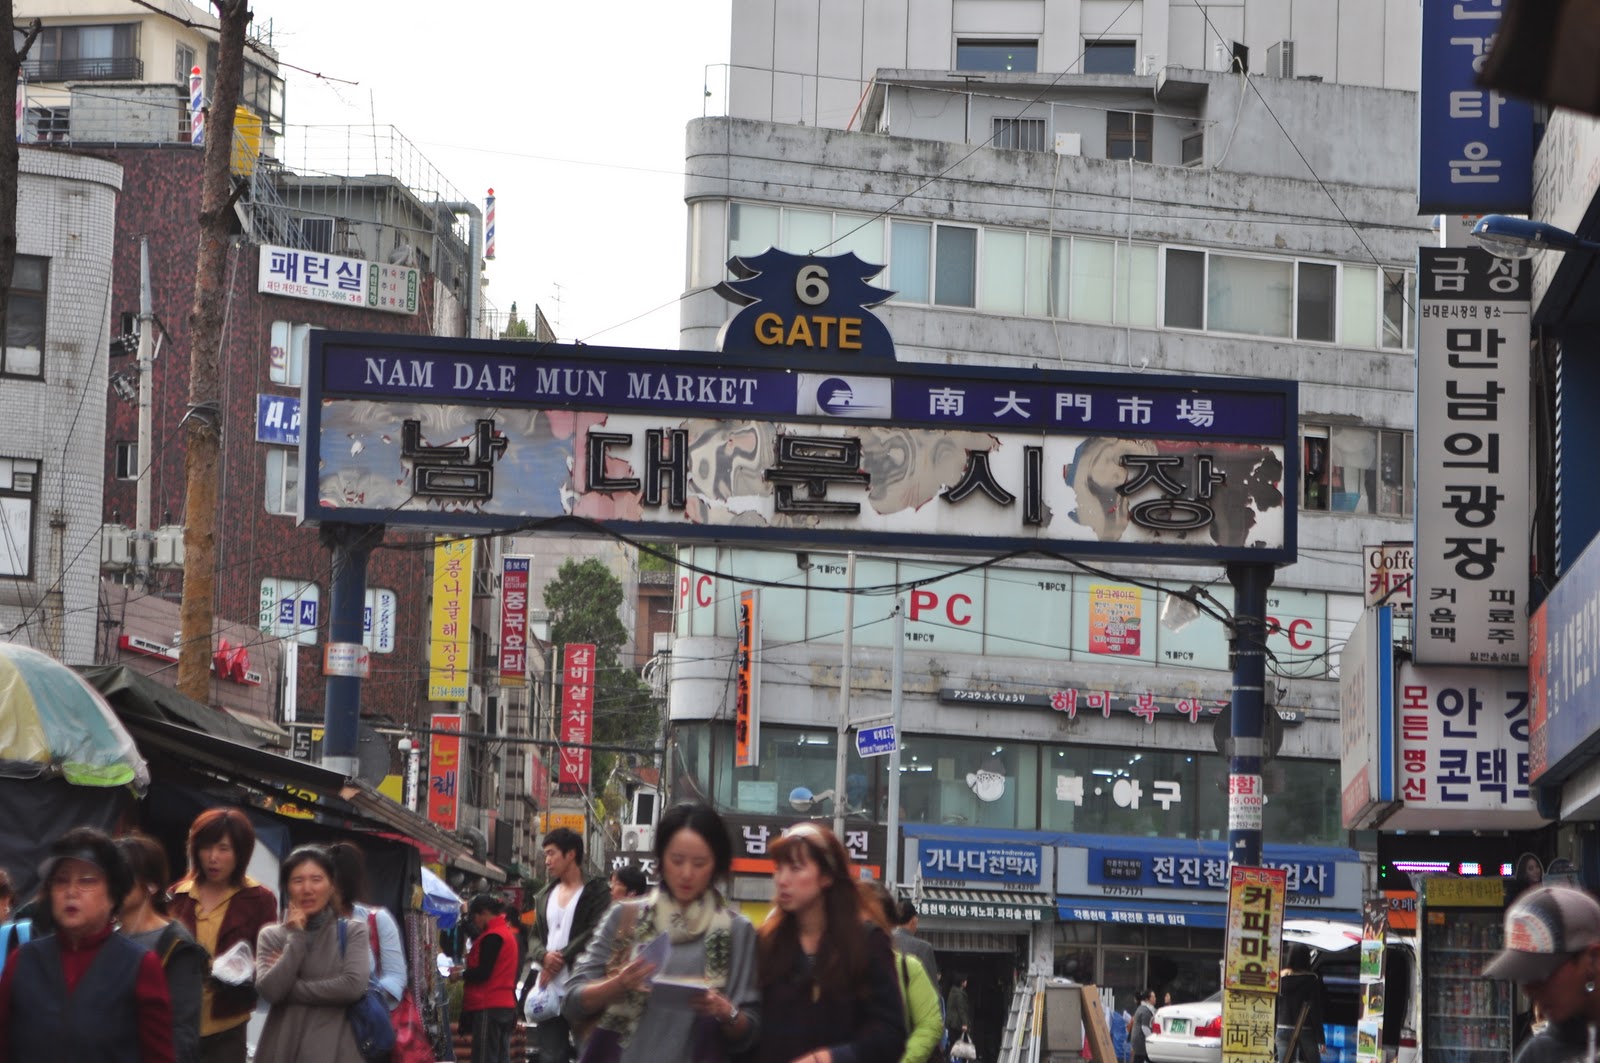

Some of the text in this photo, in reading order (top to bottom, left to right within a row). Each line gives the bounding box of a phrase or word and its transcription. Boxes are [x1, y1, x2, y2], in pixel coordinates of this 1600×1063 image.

[270, 252, 362, 292] 패턴실
[282, 284, 308, 295] 개인지도
[796, 265, 829, 305] 6
[1431, 257, 1520, 293] 금성
[1423, 305, 1501, 319] 남대문시장의 명소
[754, 312, 863, 349] GATE
[364, 358, 758, 405] NAM DAE MUN MARKET
[929, 387, 1216, 427] 南大門市場
[1442, 328, 1507, 580] 만남의광장
[402, 418, 1226, 531] 남대문시장
[680, 576, 712, 609] PC
[1370, 572, 1412, 599] 커피
[1430, 588, 1515, 605] 커피
[442, 559, 463, 683] 콩나물해장국
[909, 590, 972, 625] PC
[1430, 608, 1515, 623] 음료
[502, 592, 526, 671] 중국요리
[1430, 628, 1515, 644] 맥주
[1470, 652, 1520, 662] 일반음식점
[1402, 686, 1429, 801] 모든 명신
[926, 848, 1038, 876] 가나다 천막사
[1234, 870, 1283, 884] コーヒー
[1074, 910, 1106, 922] 각종천막
[1148, 914, 1165, 924] 판매
[1168, 915, 1186, 925] 임대
[1239, 886, 1272, 987] 커피마을
